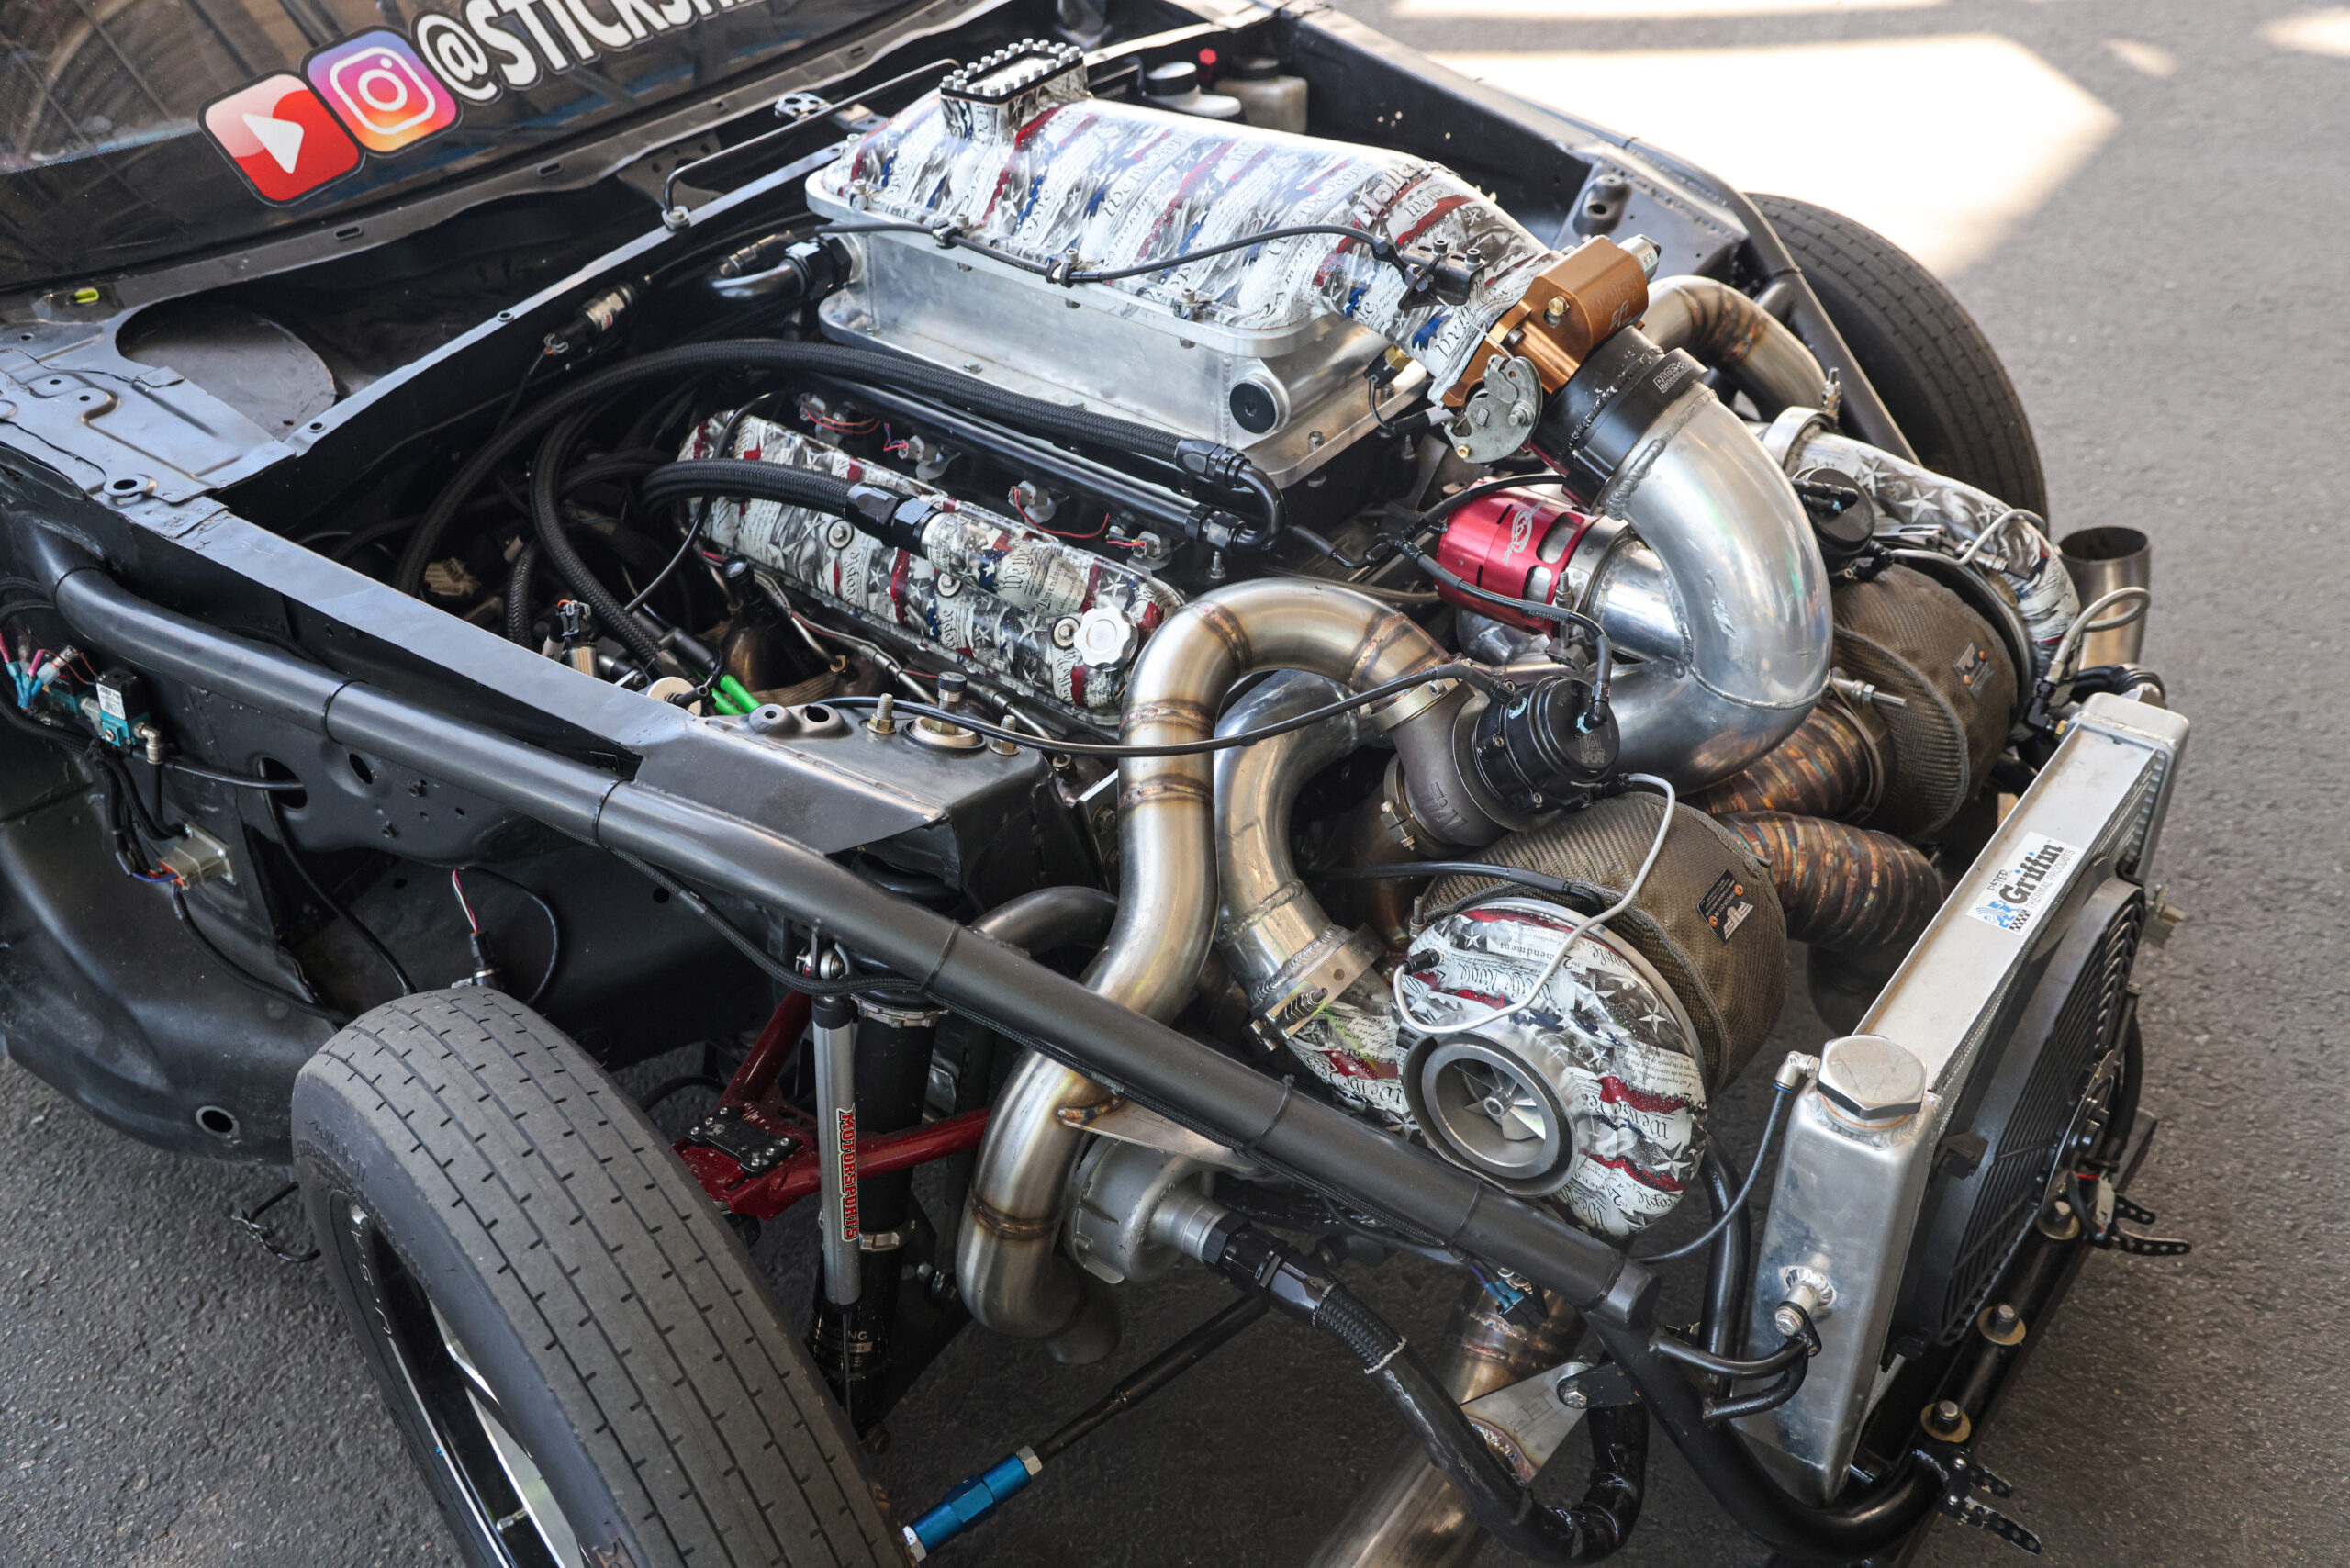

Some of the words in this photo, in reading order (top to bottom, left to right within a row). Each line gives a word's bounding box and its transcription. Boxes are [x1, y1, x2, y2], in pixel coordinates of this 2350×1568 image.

[417, 0, 752, 101] @STICK
[1352, 160, 1432, 230] Holley
[1999, 844, 2065, 904] Griffin
[2026, 880, 2051, 909] THERMAL
[1499, 941, 1557, 965] mendment
[1642, 1117, 1669, 1140] We
[841, 1113, 858, 1239] MOTORSPORTS
